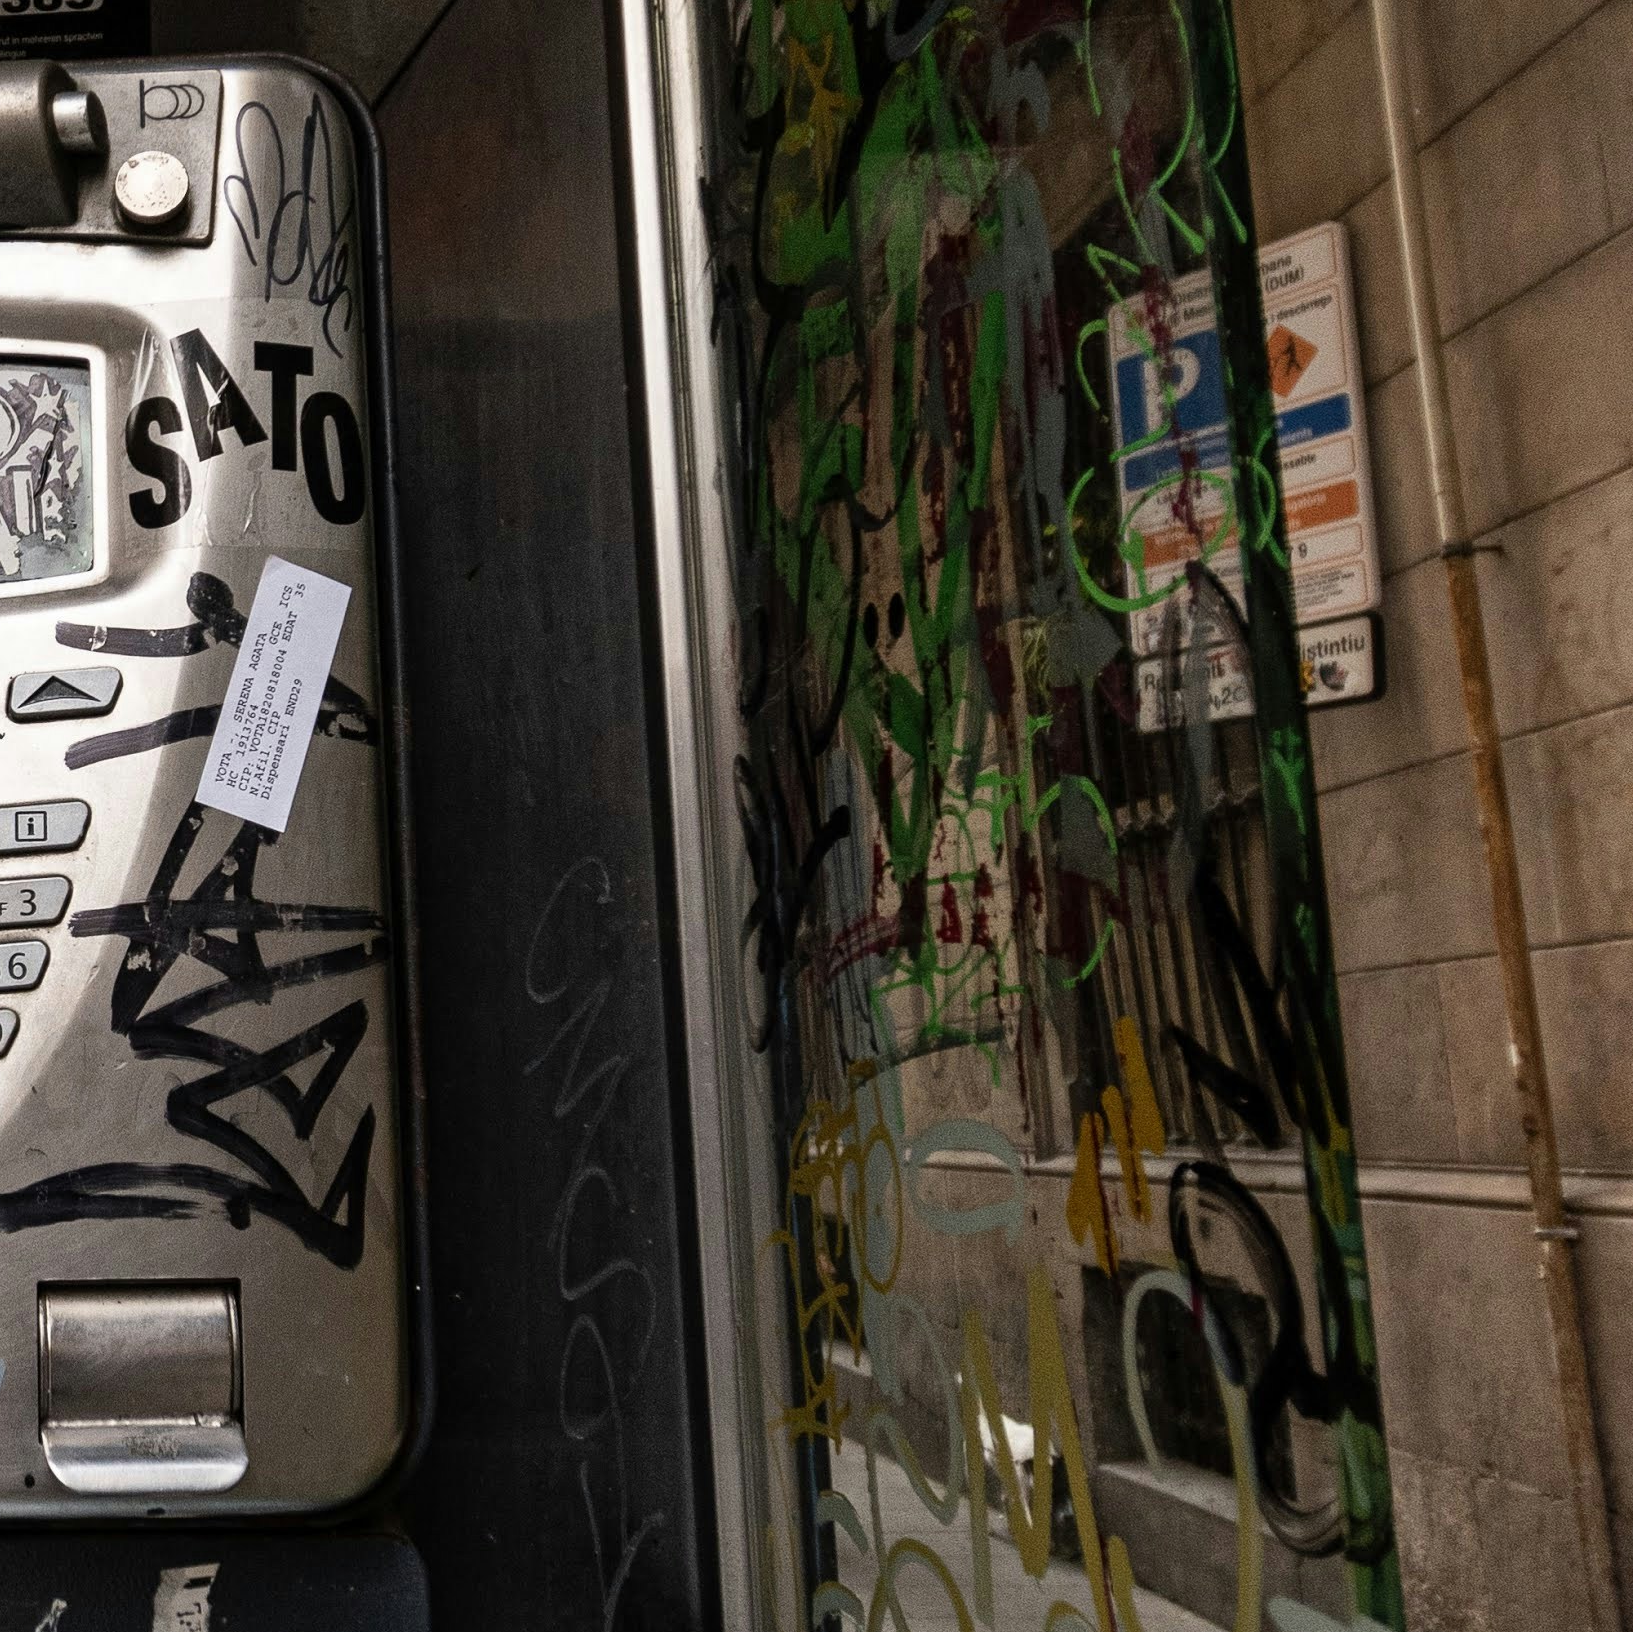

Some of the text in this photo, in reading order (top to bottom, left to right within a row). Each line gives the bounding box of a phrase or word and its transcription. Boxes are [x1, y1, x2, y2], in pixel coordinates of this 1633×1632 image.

[125, 326, 364, 527] SATO
[215, 632, 268, 784] VOTA SERENA AGATA
[226, 770, 240, 788] HC
[239, 704, 259, 758] 1913764
[279, 585, 294, 609] ICS
[238, 763, 255, 791] CIP:
[283, 611, 299, 643] EDAT
[295, 583, 307, 599] 35
[1300, 633, 1366, 662] istintiu
[261, 678, 304, 800] Dispensari END29
[267, 710, 281, 736] CIP
[18, 889, 37, 917] 3
[8, 952, 28, 980] 6
